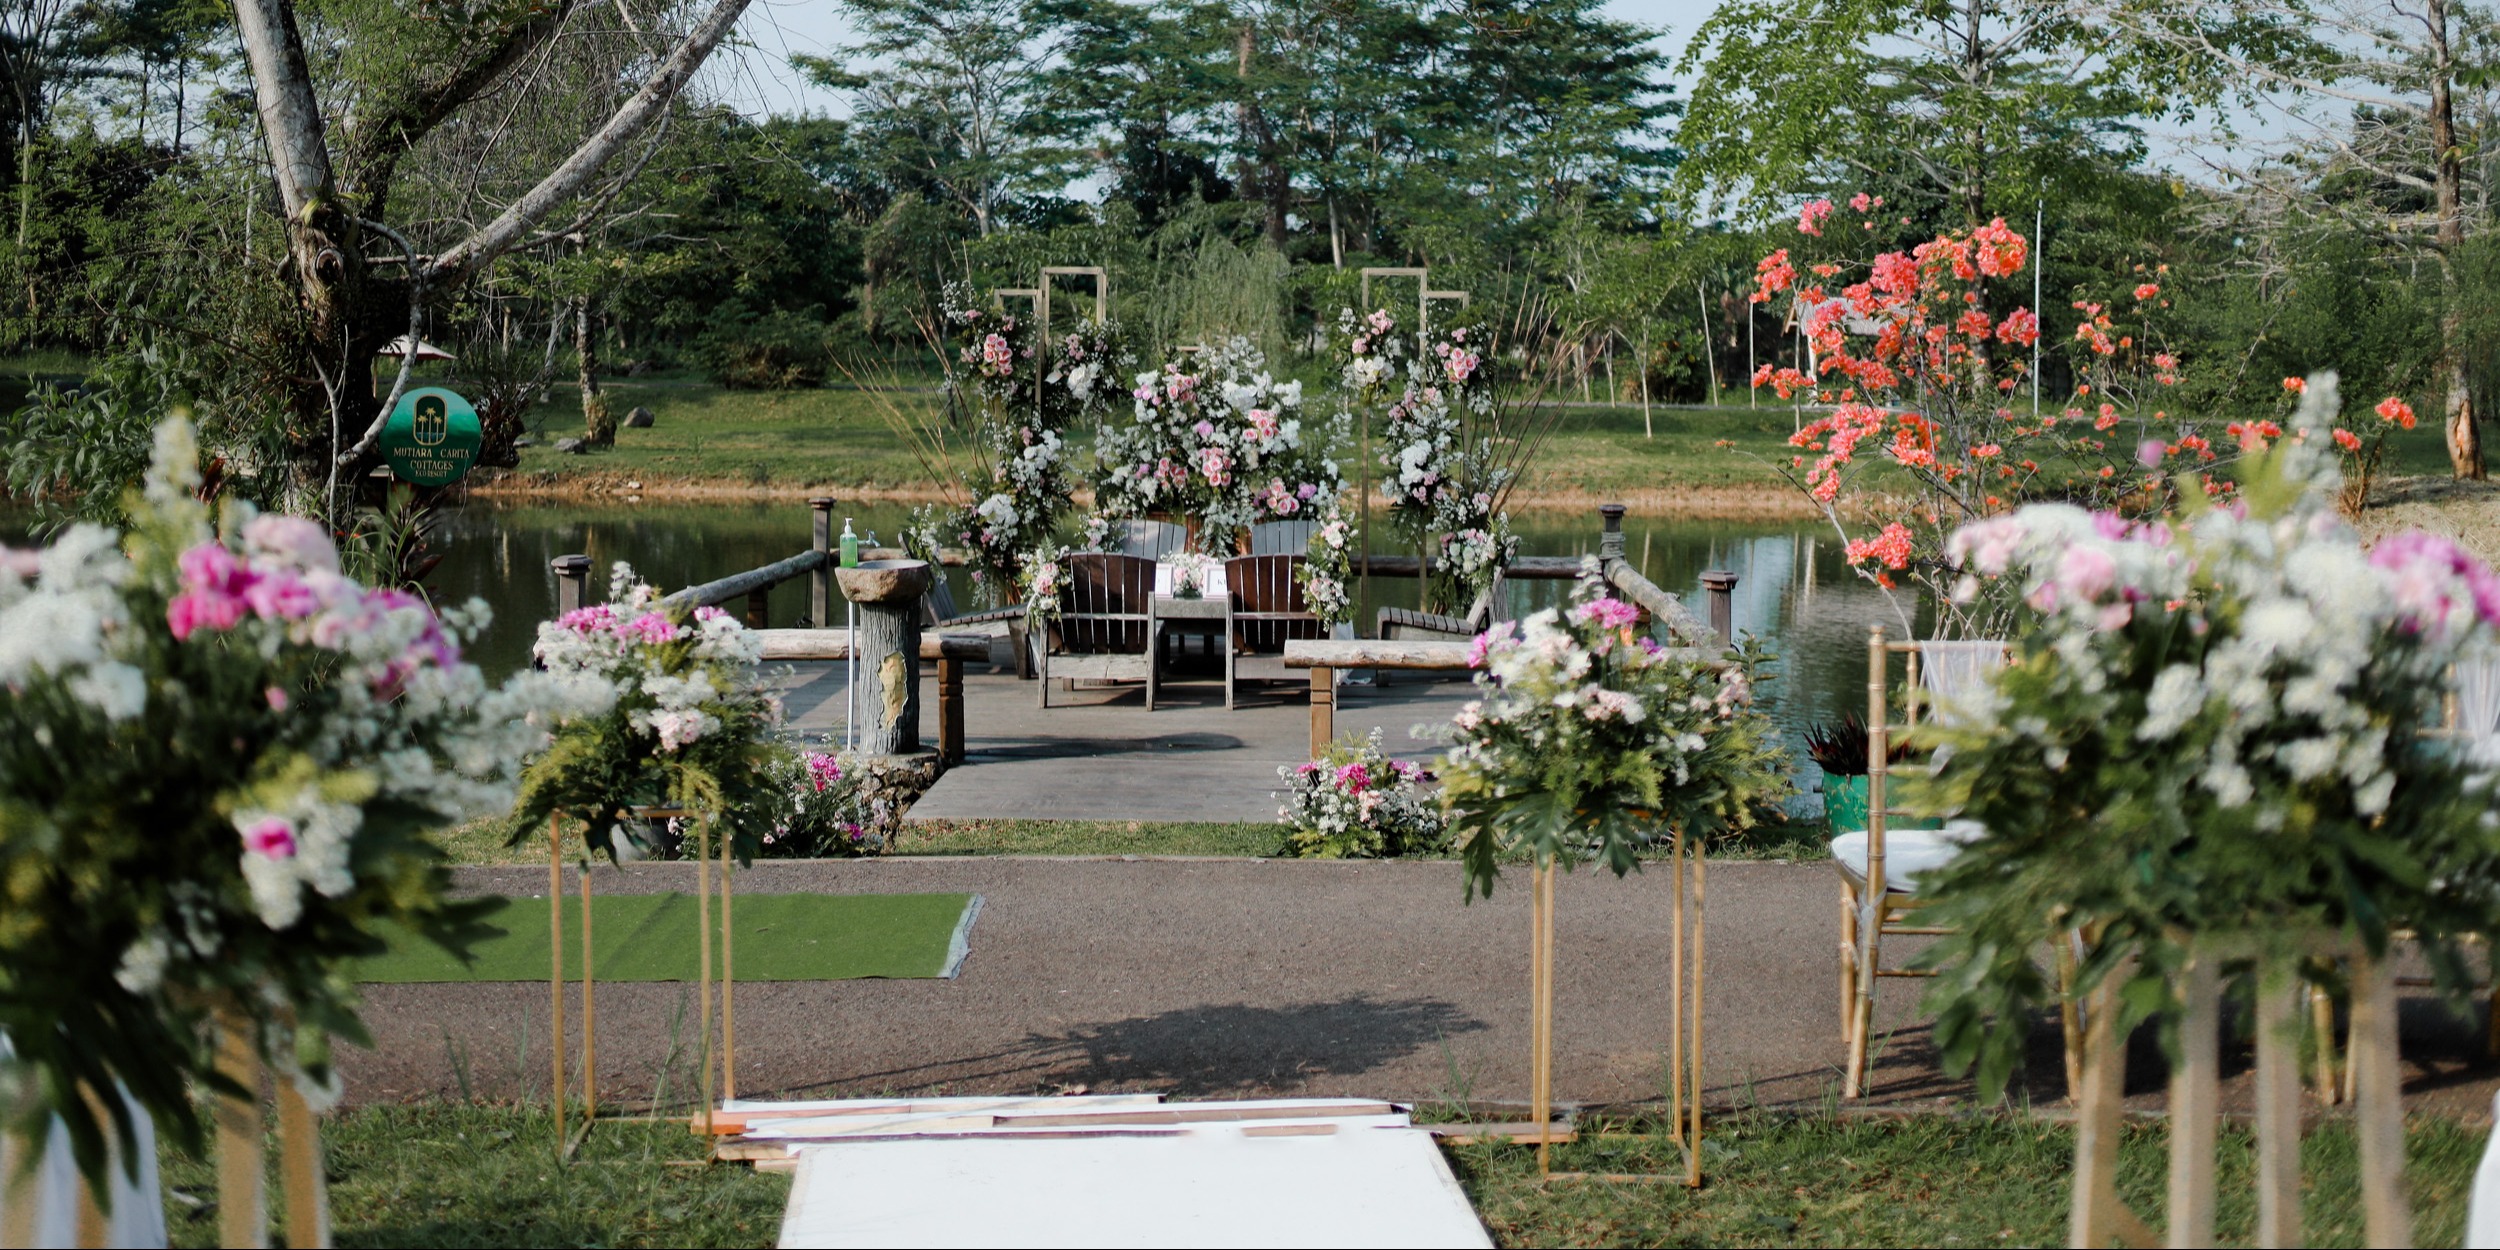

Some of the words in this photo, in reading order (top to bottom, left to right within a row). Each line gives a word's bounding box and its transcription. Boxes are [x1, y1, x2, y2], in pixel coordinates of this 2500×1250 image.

[394, 447, 432, 458] MUTIARA
[440, 448, 469, 458] CARITA
[410, 460, 453, 470] COTTAGES
[428, 470, 447, 478] RESORT
